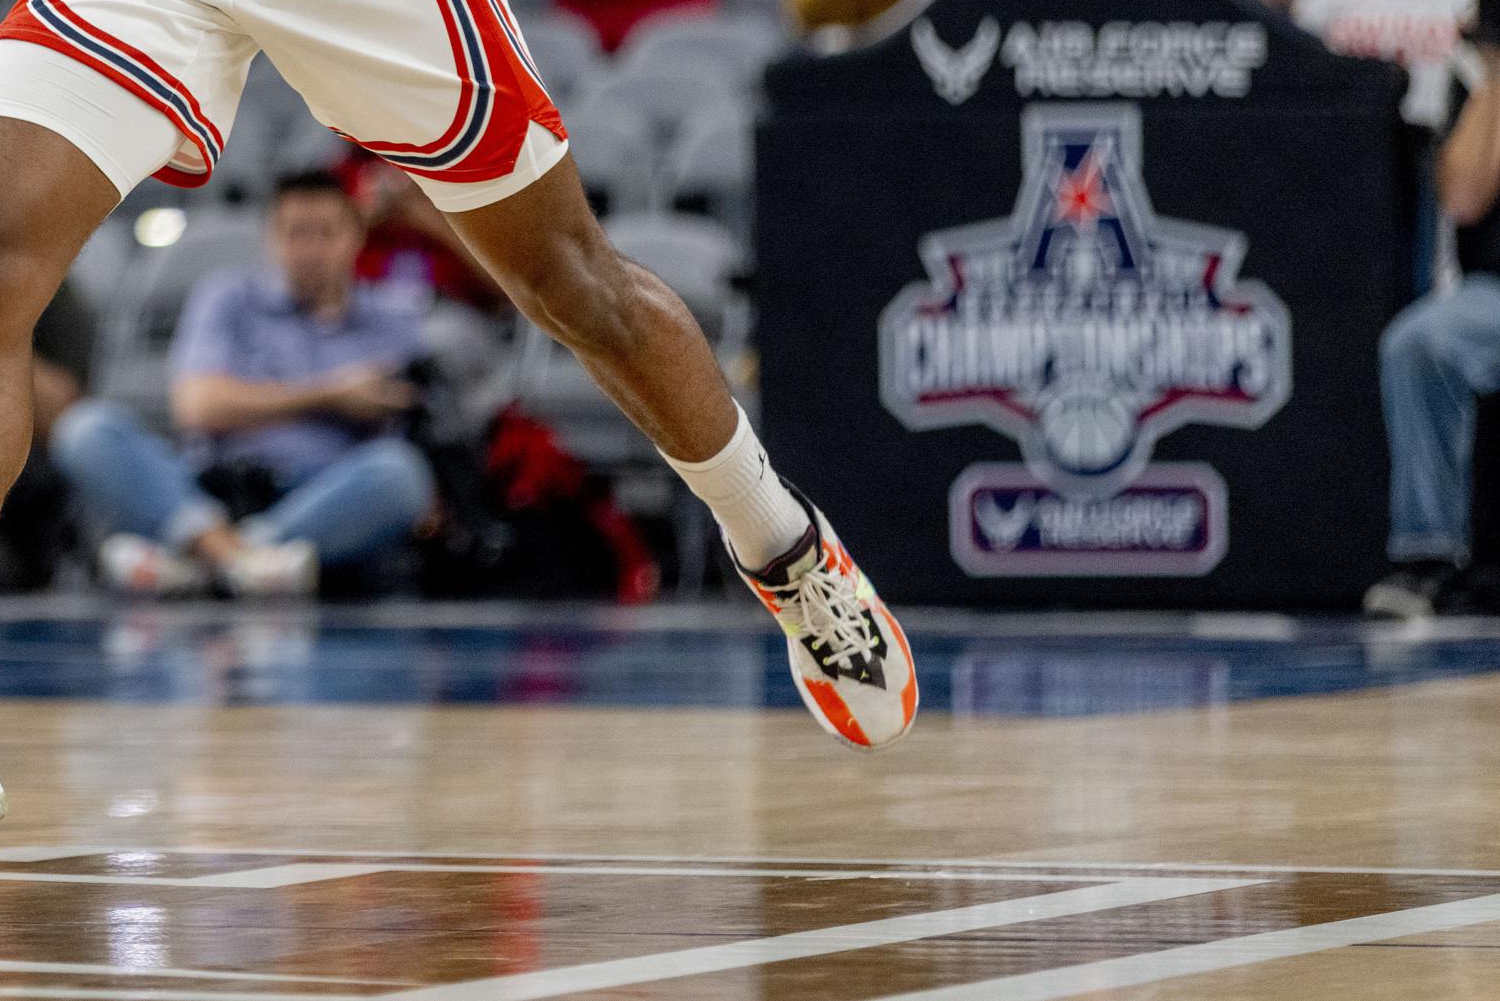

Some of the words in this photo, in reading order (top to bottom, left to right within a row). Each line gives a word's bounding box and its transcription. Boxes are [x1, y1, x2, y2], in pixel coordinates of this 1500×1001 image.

[1001, 20, 1095, 66] AIR
[1098, 20, 1269, 69] FORCE
[1014, 60, 1253, 98] RESERVE
